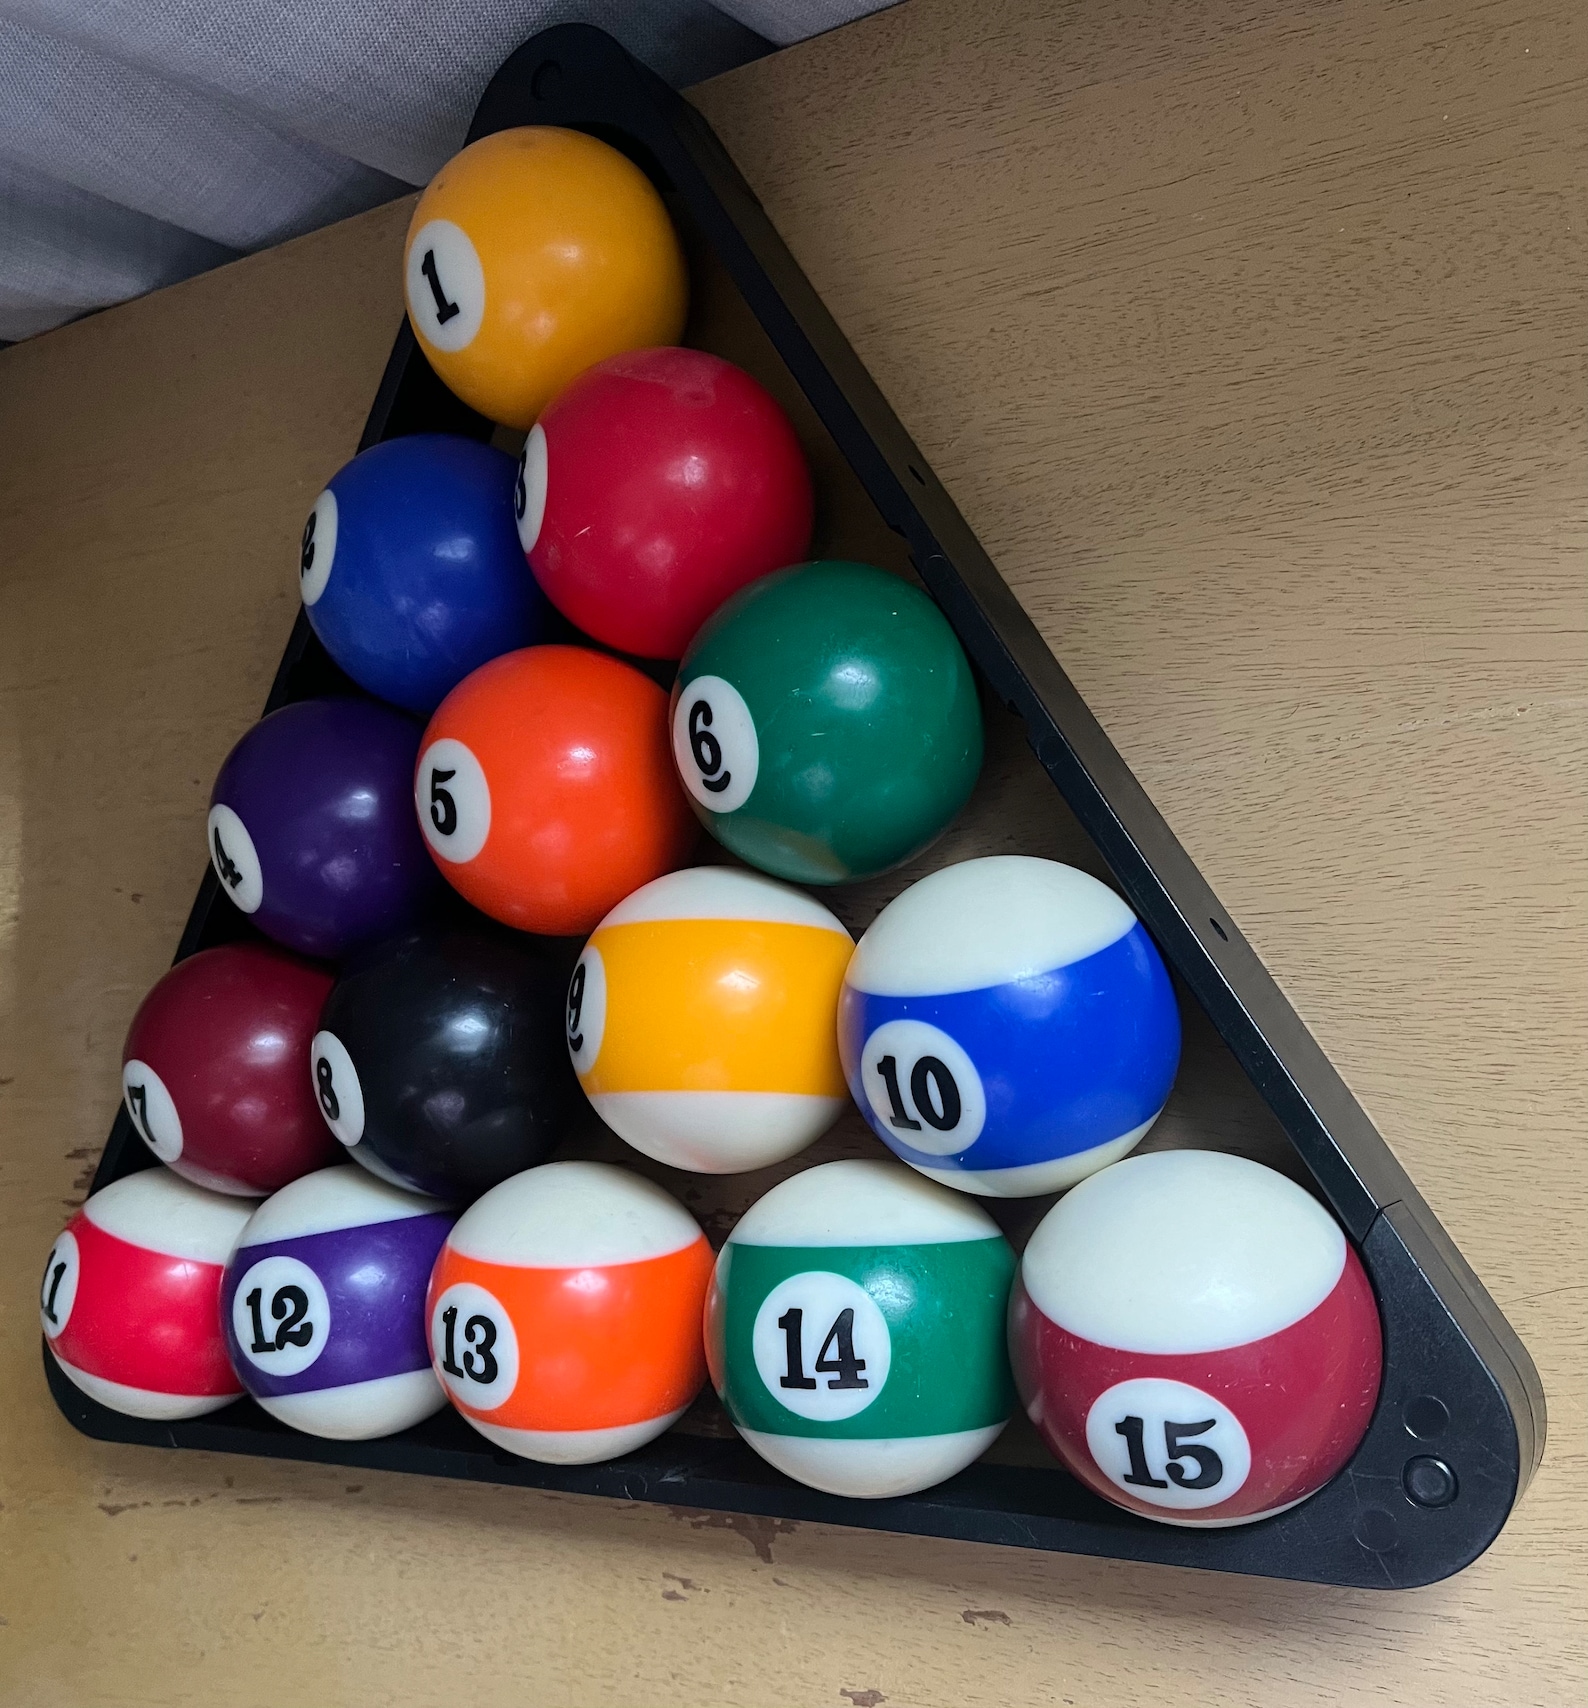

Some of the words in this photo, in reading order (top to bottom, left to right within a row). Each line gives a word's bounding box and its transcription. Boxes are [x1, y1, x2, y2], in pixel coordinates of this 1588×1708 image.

[421, 249, 460, 325] 1
[515, 449, 527, 520] 3
[301, 511, 317, 578] 2
[690, 700, 731, 793] 6
[430, 768, 458, 836] 5
[214, 826, 243, 889] 4
[566, 963, 586, 1049] 9
[127, 1084, 157, 1143] 7
[316, 1057, 340, 1121] 8
[877, 1055, 962, 1132] 10
[246, 1285, 314, 1355] 12
[442, 1305, 498, 1385] 13
[778, 1308, 869, 1391] 14
[1114, 1416, 1224, 1490] 15
